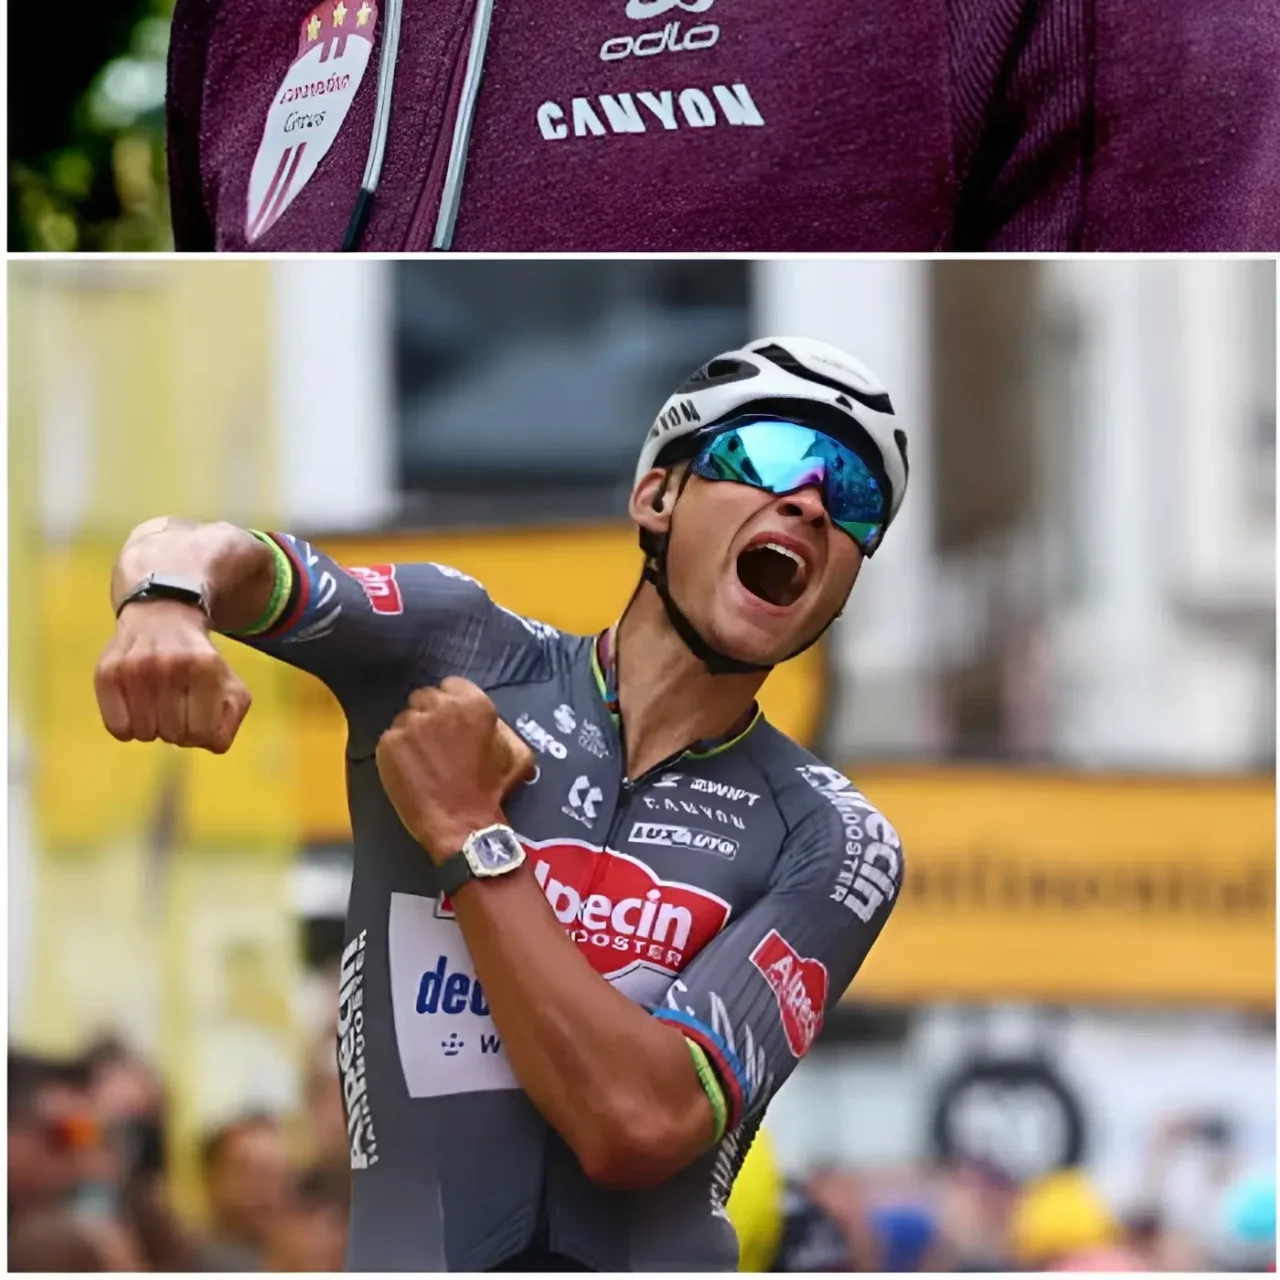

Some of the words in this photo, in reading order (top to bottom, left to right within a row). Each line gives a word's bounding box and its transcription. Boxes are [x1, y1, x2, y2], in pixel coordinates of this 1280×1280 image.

[600, 21, 721, 62] odlo
[537, 83, 765, 141] CANYON
[534, 859, 693, 952] lpecin
[566, 928, 683, 967] OOSTER
